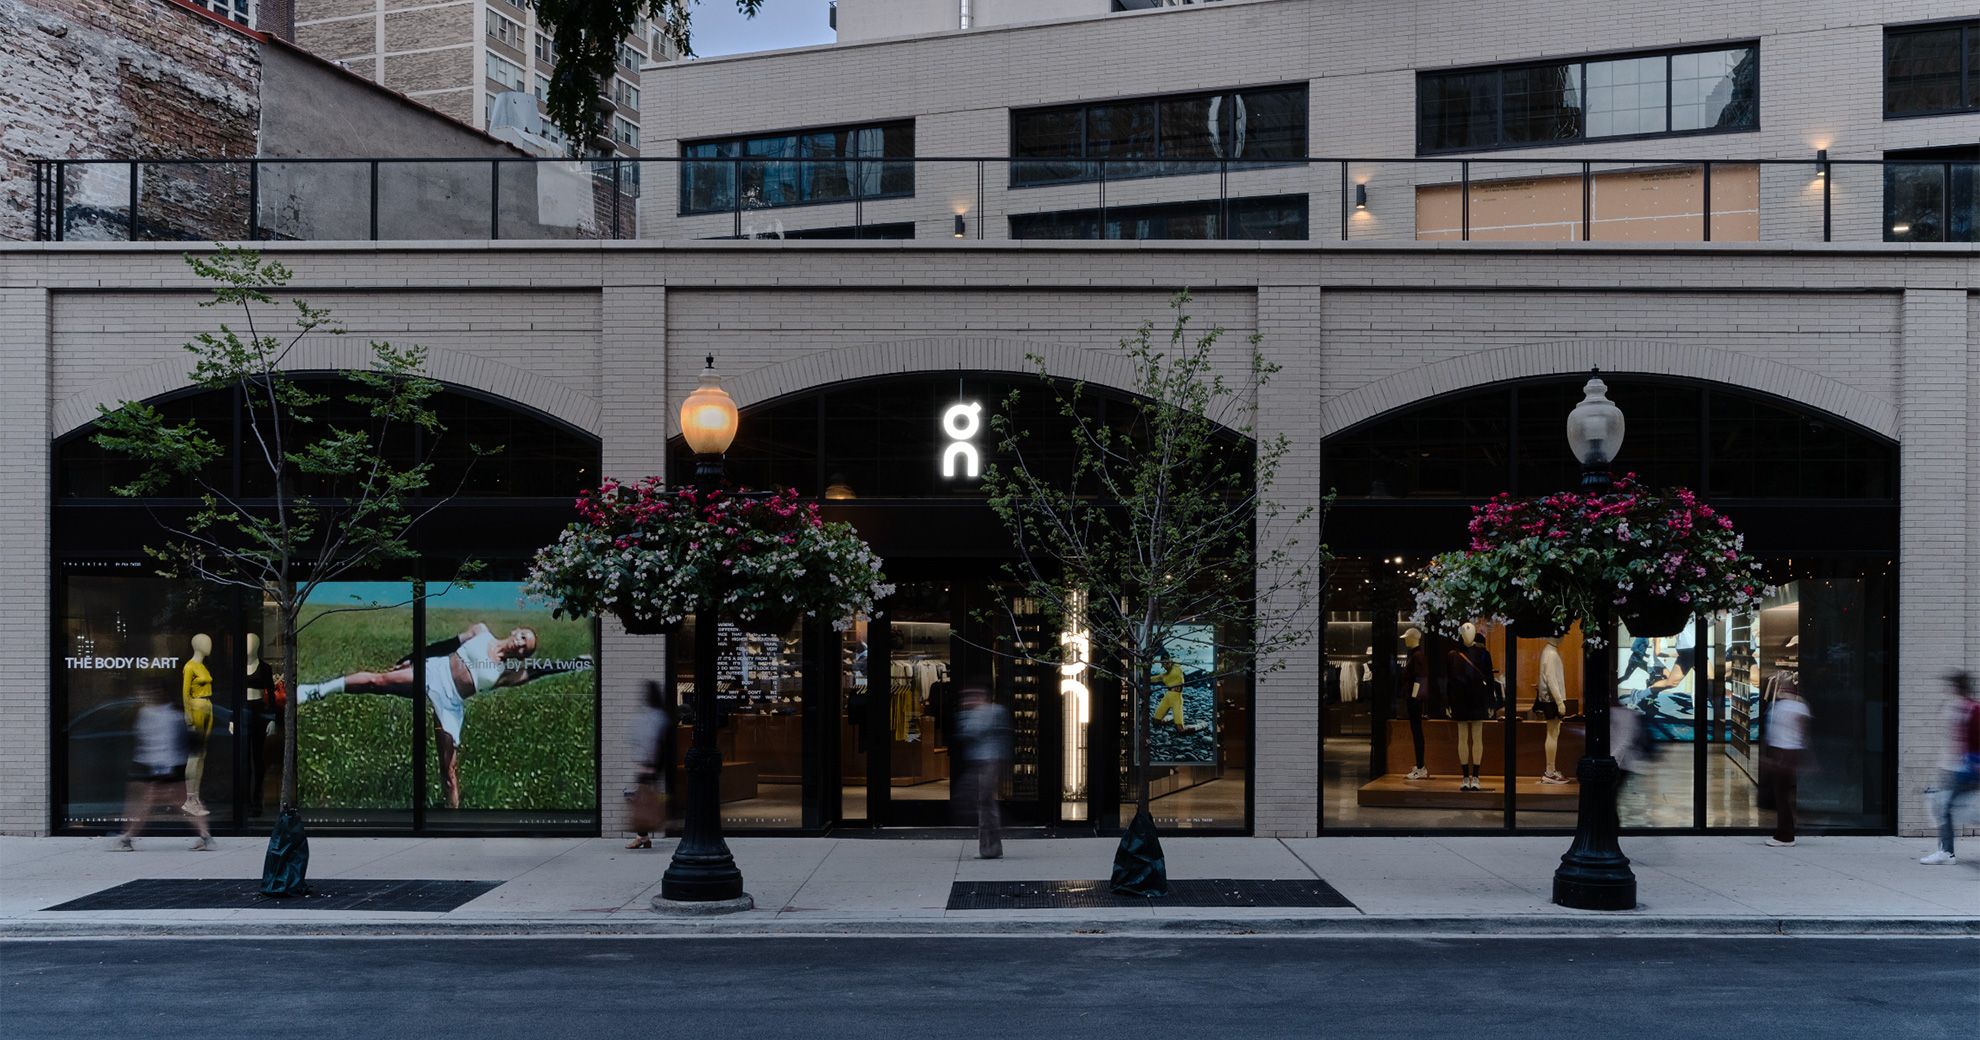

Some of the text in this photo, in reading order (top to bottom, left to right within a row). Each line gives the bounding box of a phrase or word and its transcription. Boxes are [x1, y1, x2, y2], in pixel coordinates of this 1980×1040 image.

[65, 657, 179, 669] THE BODY IS ART
[506, 658, 521, 672] by
[524, 658, 553, 670] FKA
[555, 658, 591, 672] twigs
